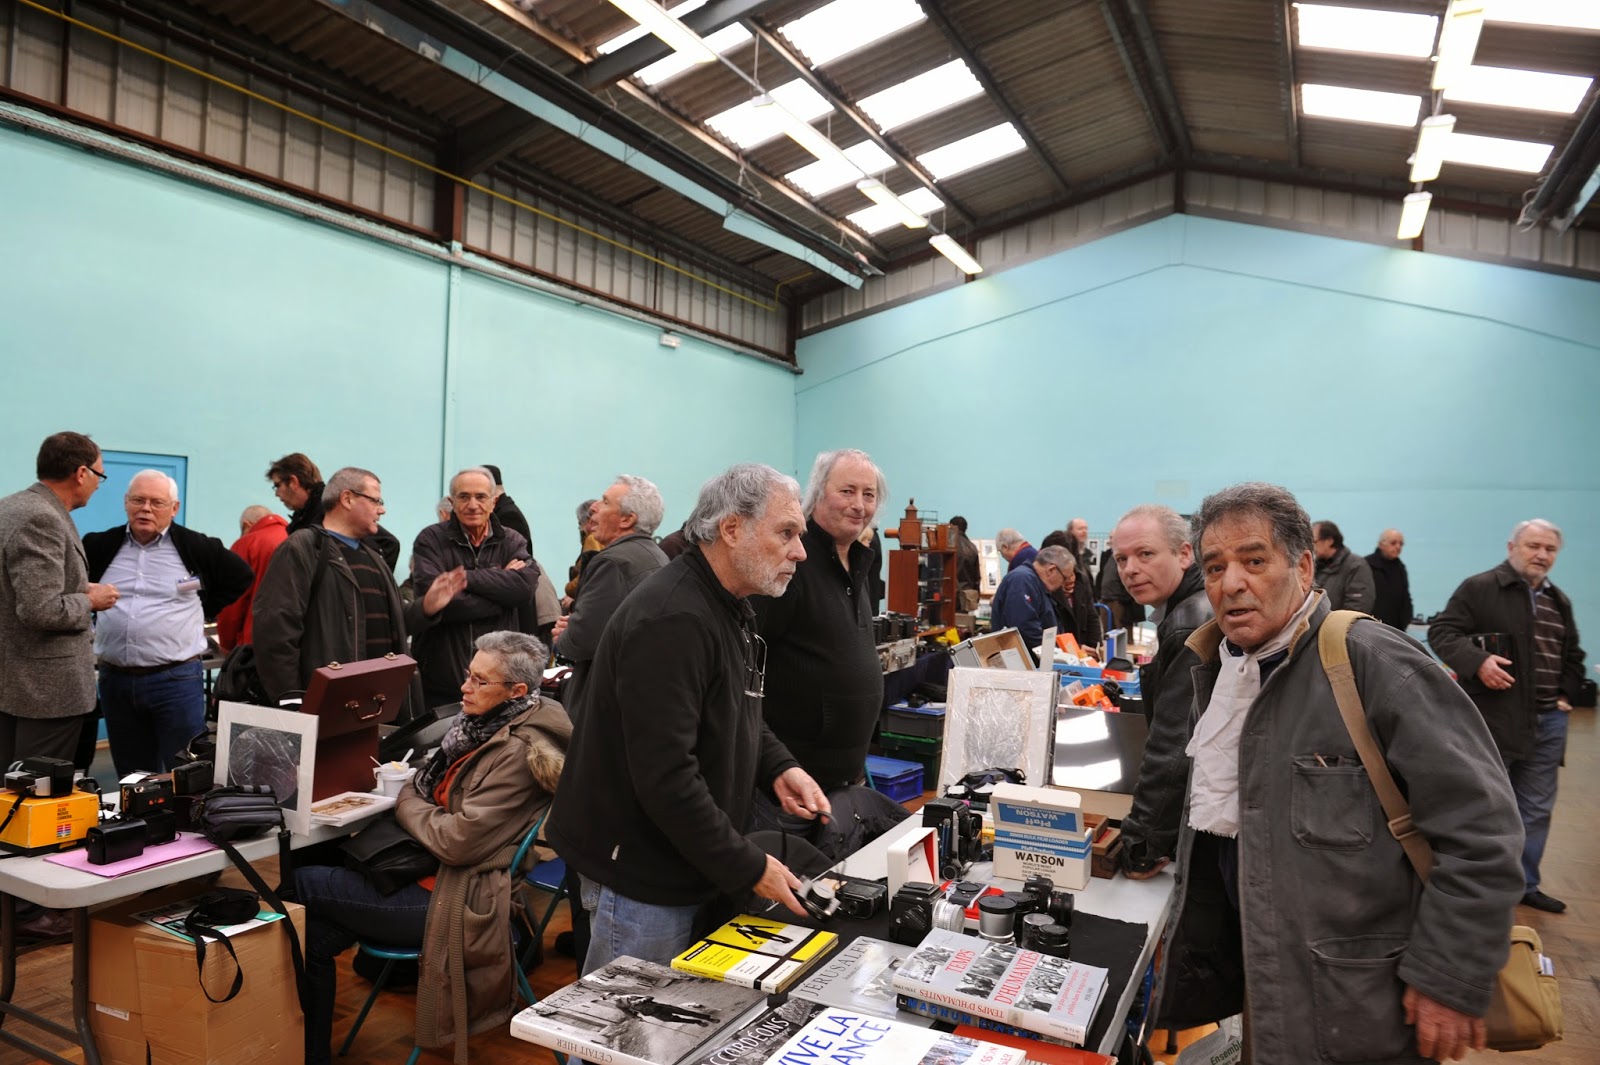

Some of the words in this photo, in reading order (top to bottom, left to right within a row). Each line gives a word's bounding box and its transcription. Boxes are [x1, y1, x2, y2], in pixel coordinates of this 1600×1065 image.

[1016, 810, 1058, 820] WATSON
[1026, 818, 1051, 827] Pfaff
[1015, 851, 1064, 867] WATSON
[800, 938, 876, 996] JÉRUSALEM
[944, 949, 976, 974] TEMPS
[995, 950, 1039, 1004] D'HUMANITÉS
[920, 989, 976, 1010] D'HUMANITÉS
[908, 999, 972, 1024] MAGNUM
[978, 1006, 1004, 1018] TEMPS
[814, 1016, 859, 1037] LA
[557, 1038, 577, 1051] HIER
[702, 1018, 790, 1065] CCORDÉONS
[580, 1046, 613, 1064] C'ÉTAIT
